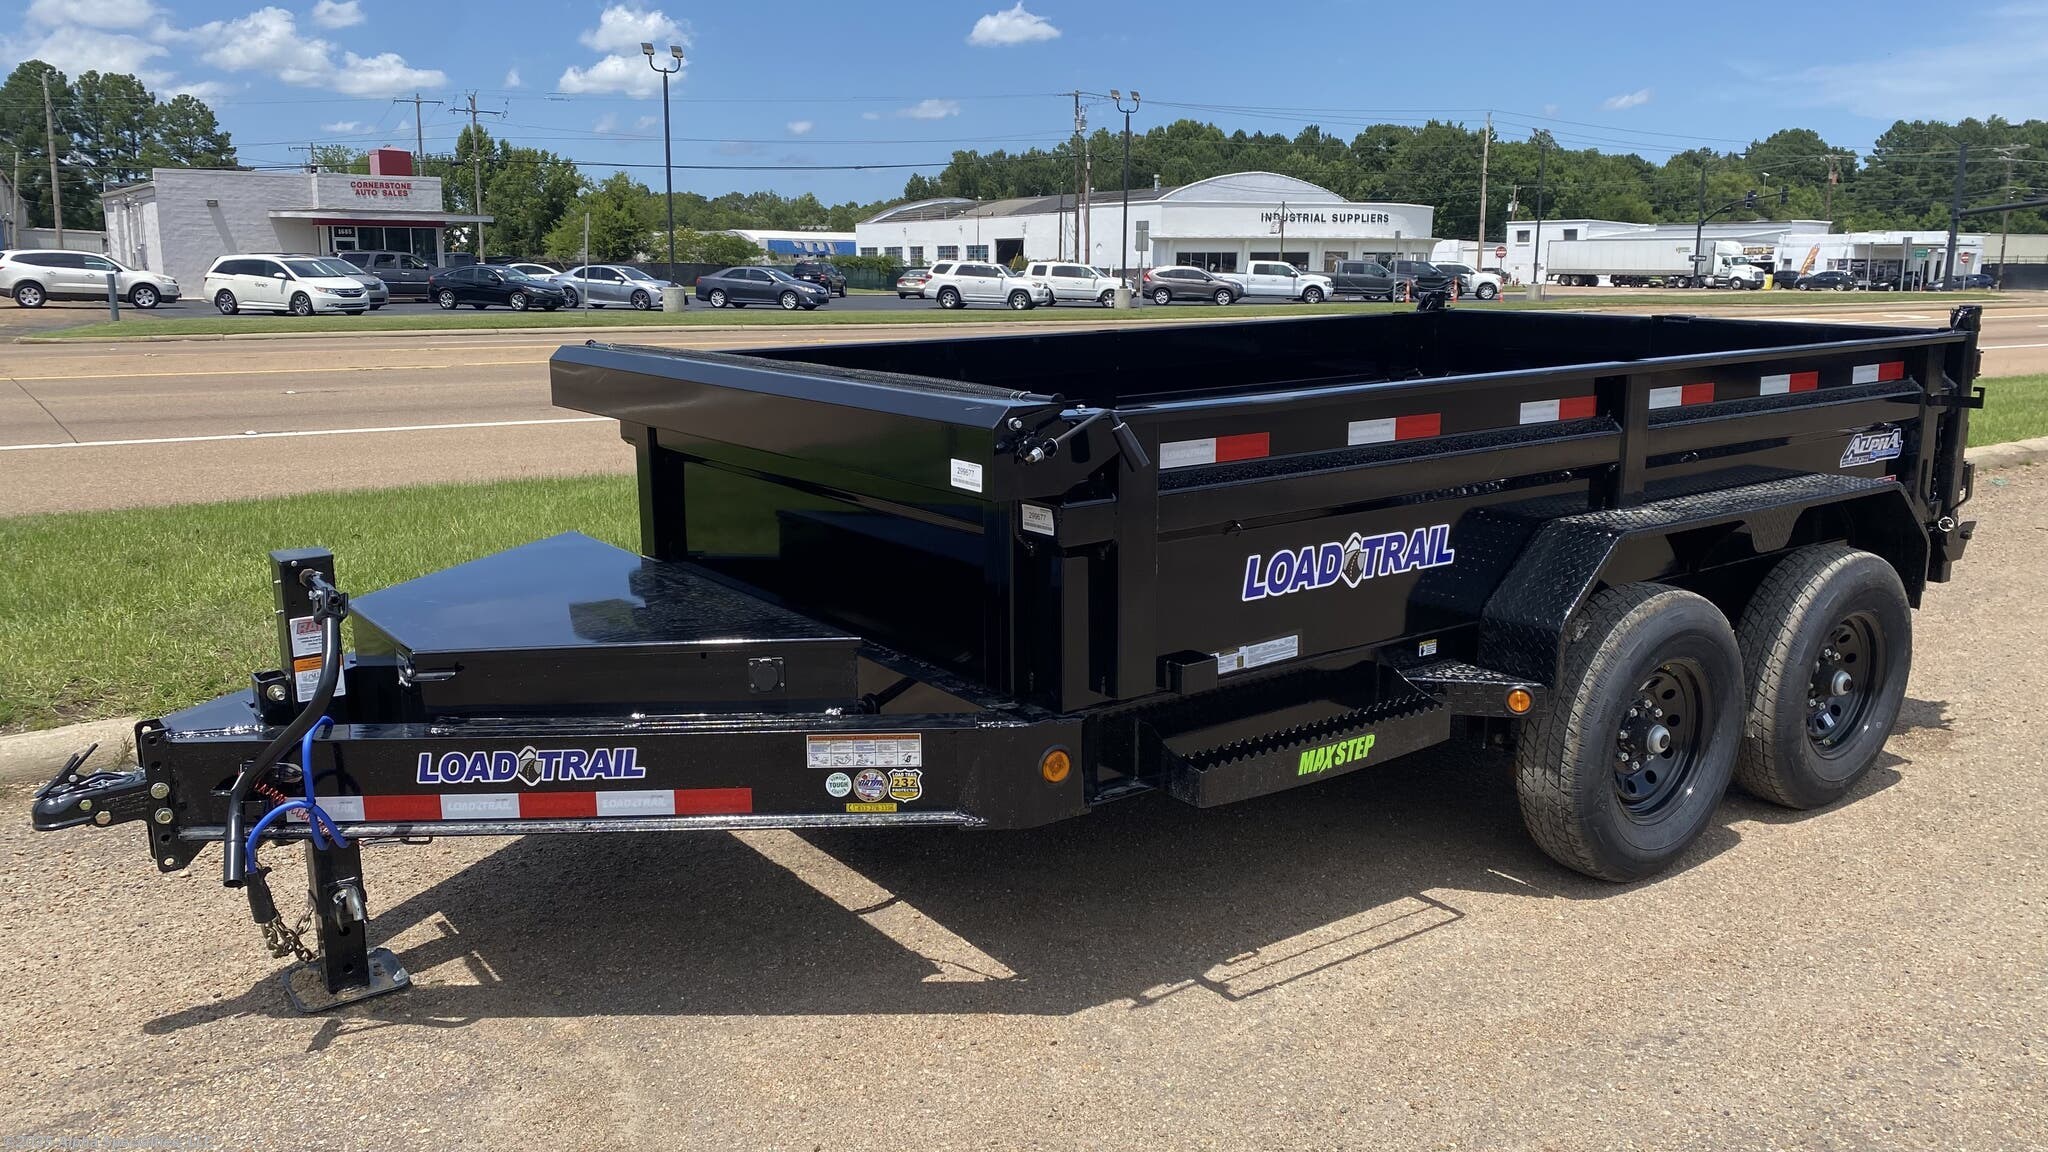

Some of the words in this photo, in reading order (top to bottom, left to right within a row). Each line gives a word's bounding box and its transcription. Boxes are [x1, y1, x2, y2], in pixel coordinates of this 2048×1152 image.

[350, 181, 412, 190] CORNERSTONE
[355, 189, 378, 197] AUTO
[1261, 212, 1326, 223] INDUSTRIAL
[1331, 213, 1389, 223] SUPPLIERS
[1846, 431, 1901, 457] ALPHA
[1242, 541, 1344, 602] LOAD
[1361, 523, 1455, 580] TRAIL
[298, 621, 322, 634] RA
[1298, 734, 1377, 777] MAXSTEP
[416, 751, 520, 785] LOAD
[534, 747, 646, 782] TRAIL
[894, 778, 916, 788] 232
